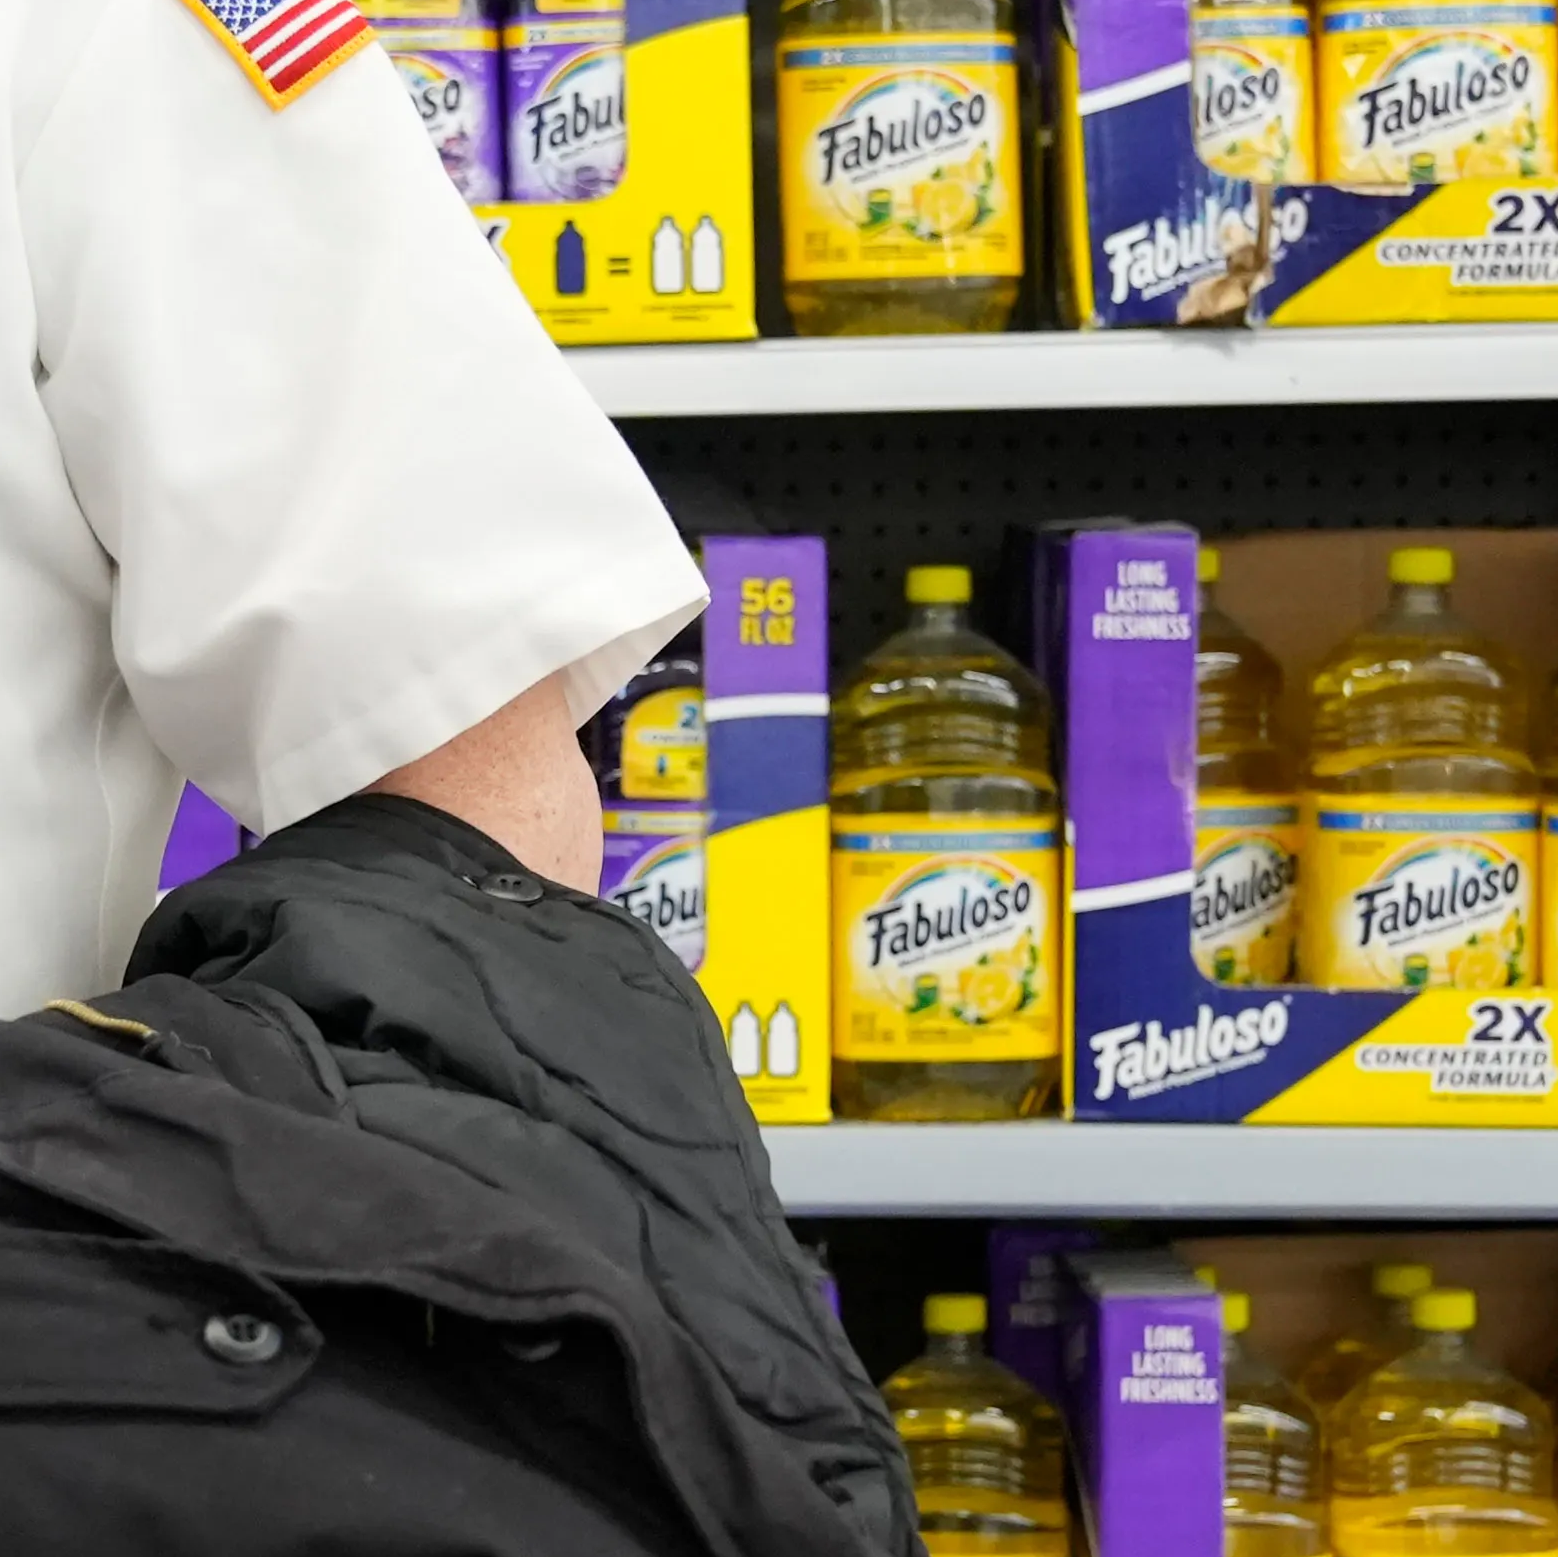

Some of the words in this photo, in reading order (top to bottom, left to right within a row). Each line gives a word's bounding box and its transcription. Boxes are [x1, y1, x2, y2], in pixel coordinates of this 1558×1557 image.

[1359, 54, 1530, 149] Fabuloso
[529, 84, 625, 162] Fabu
[818, 92, 987, 186] Fabuloso
[1103, 192, 1310, 305] Fabulo
[1117, 561, 1168, 587] LONG
[739, 578, 794, 616] 56
[1104, 588, 1179, 613] LASTING
[739, 617, 765, 646] FL
[767, 617, 796, 646] OZ
[1092, 613, 1191, 642] FRESHNESS
[1189, 848, 1298, 930] abuloso
[1354, 858, 1520, 947] Fabuloso
[865, 880, 1031, 968] Fabuloso
[1471, 1004, 1546, 1043] 2X
[1089, 1000, 1288, 1102] Fabuloso
[1358, 1048, 1549, 1070] CONCENTRATED
[1434, 1069, 1548, 1090] FORMULA
[1143, 1324, 1194, 1352] LONG
[1132, 1351, 1206, 1378] LASTING
[1120, 1376, 1219, 1405] FRESHNESS
